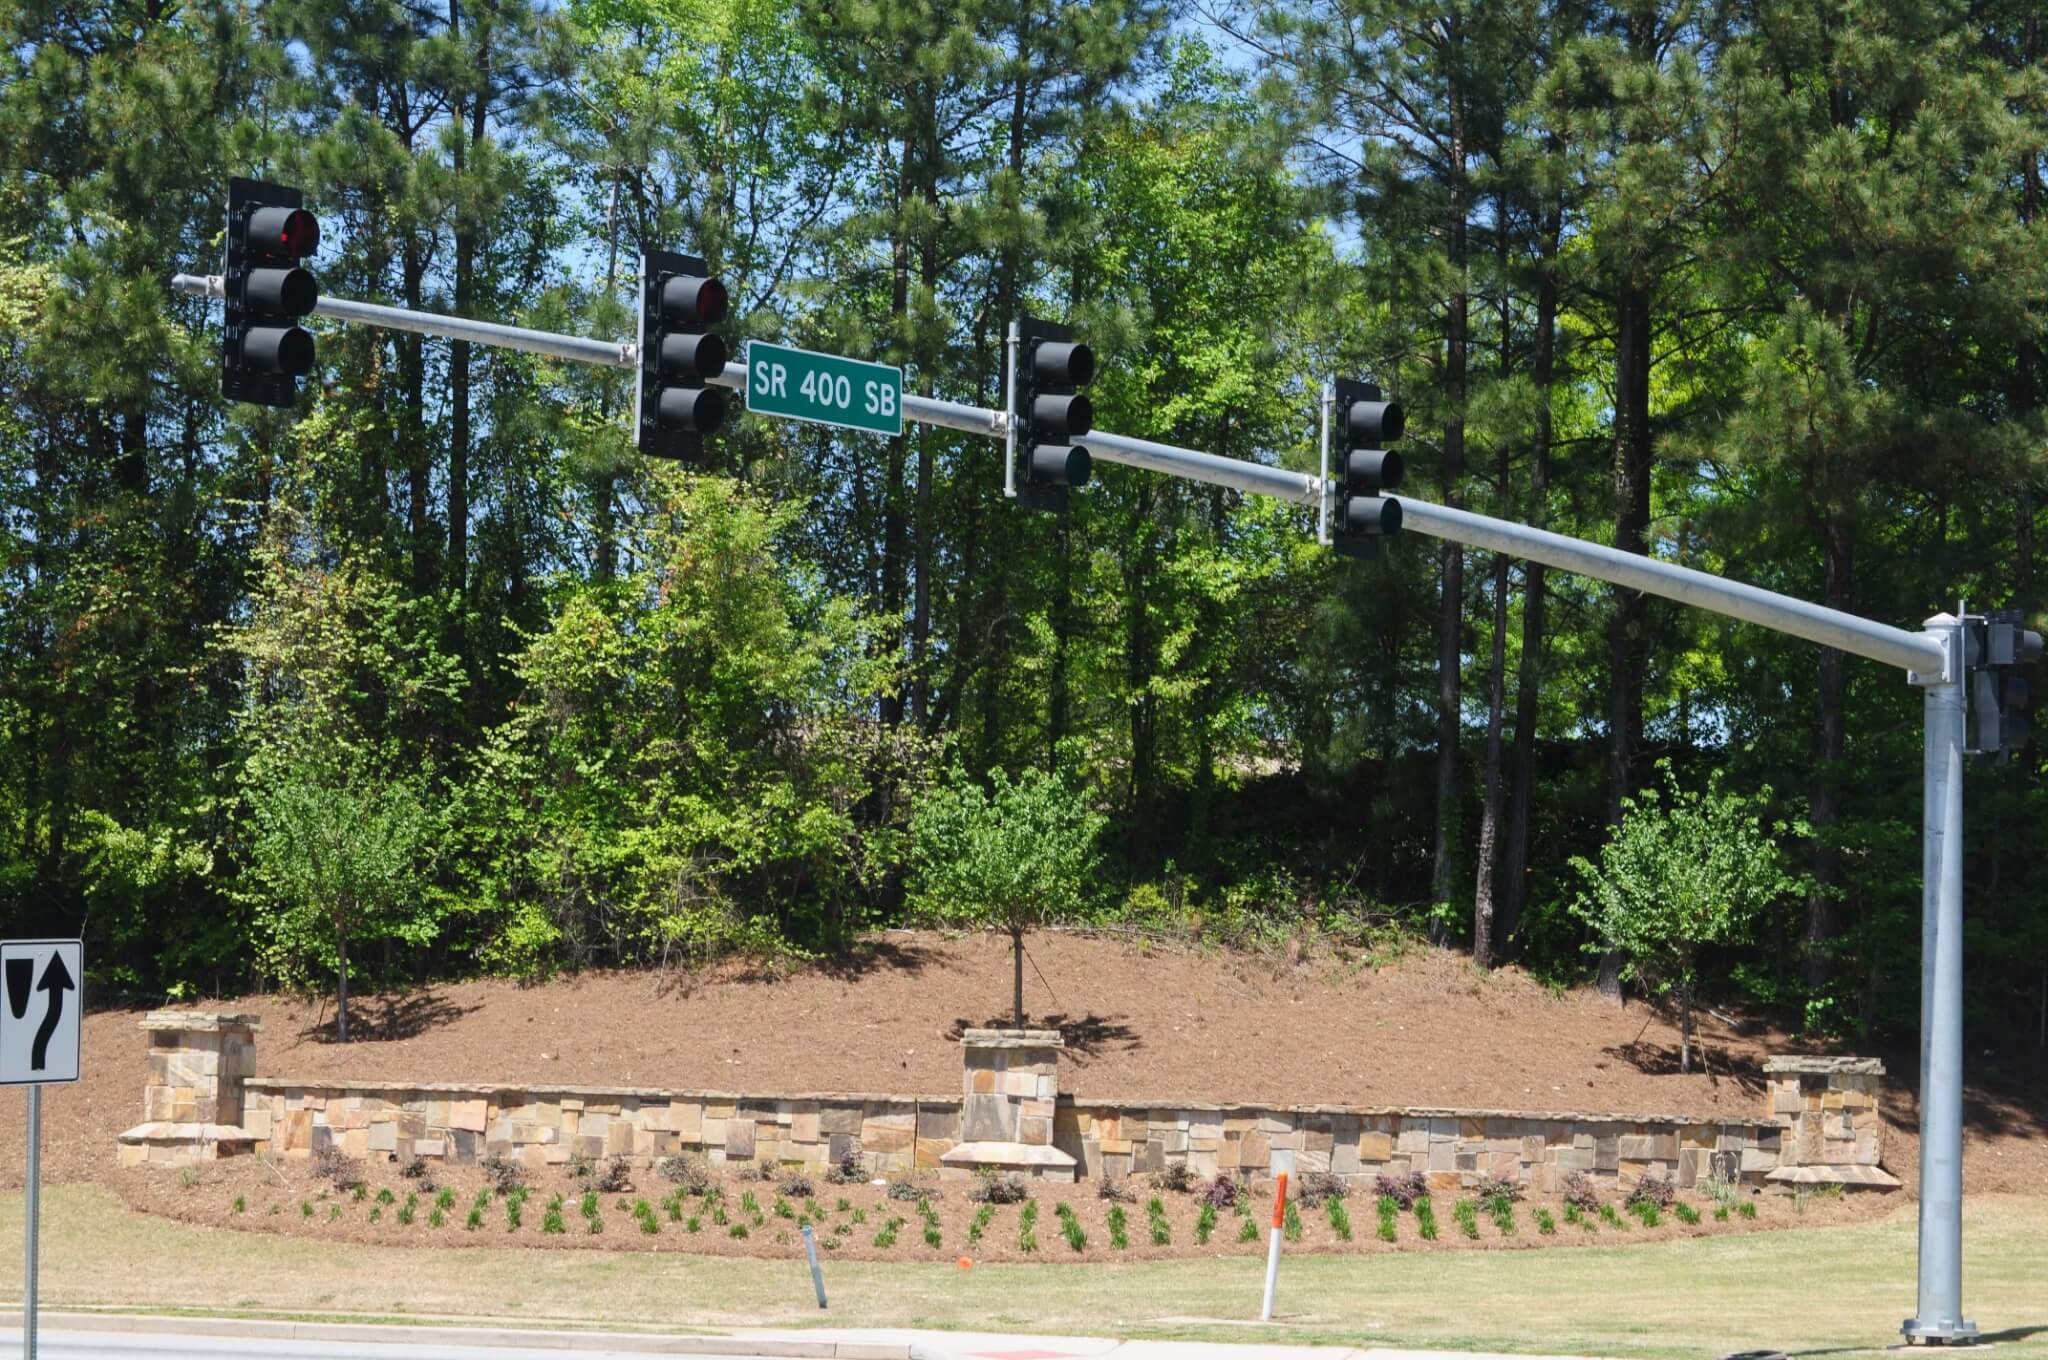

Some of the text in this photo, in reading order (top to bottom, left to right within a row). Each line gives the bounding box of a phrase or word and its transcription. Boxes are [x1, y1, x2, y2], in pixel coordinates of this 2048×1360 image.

[754, 360, 896, 417] SR 400 SB
